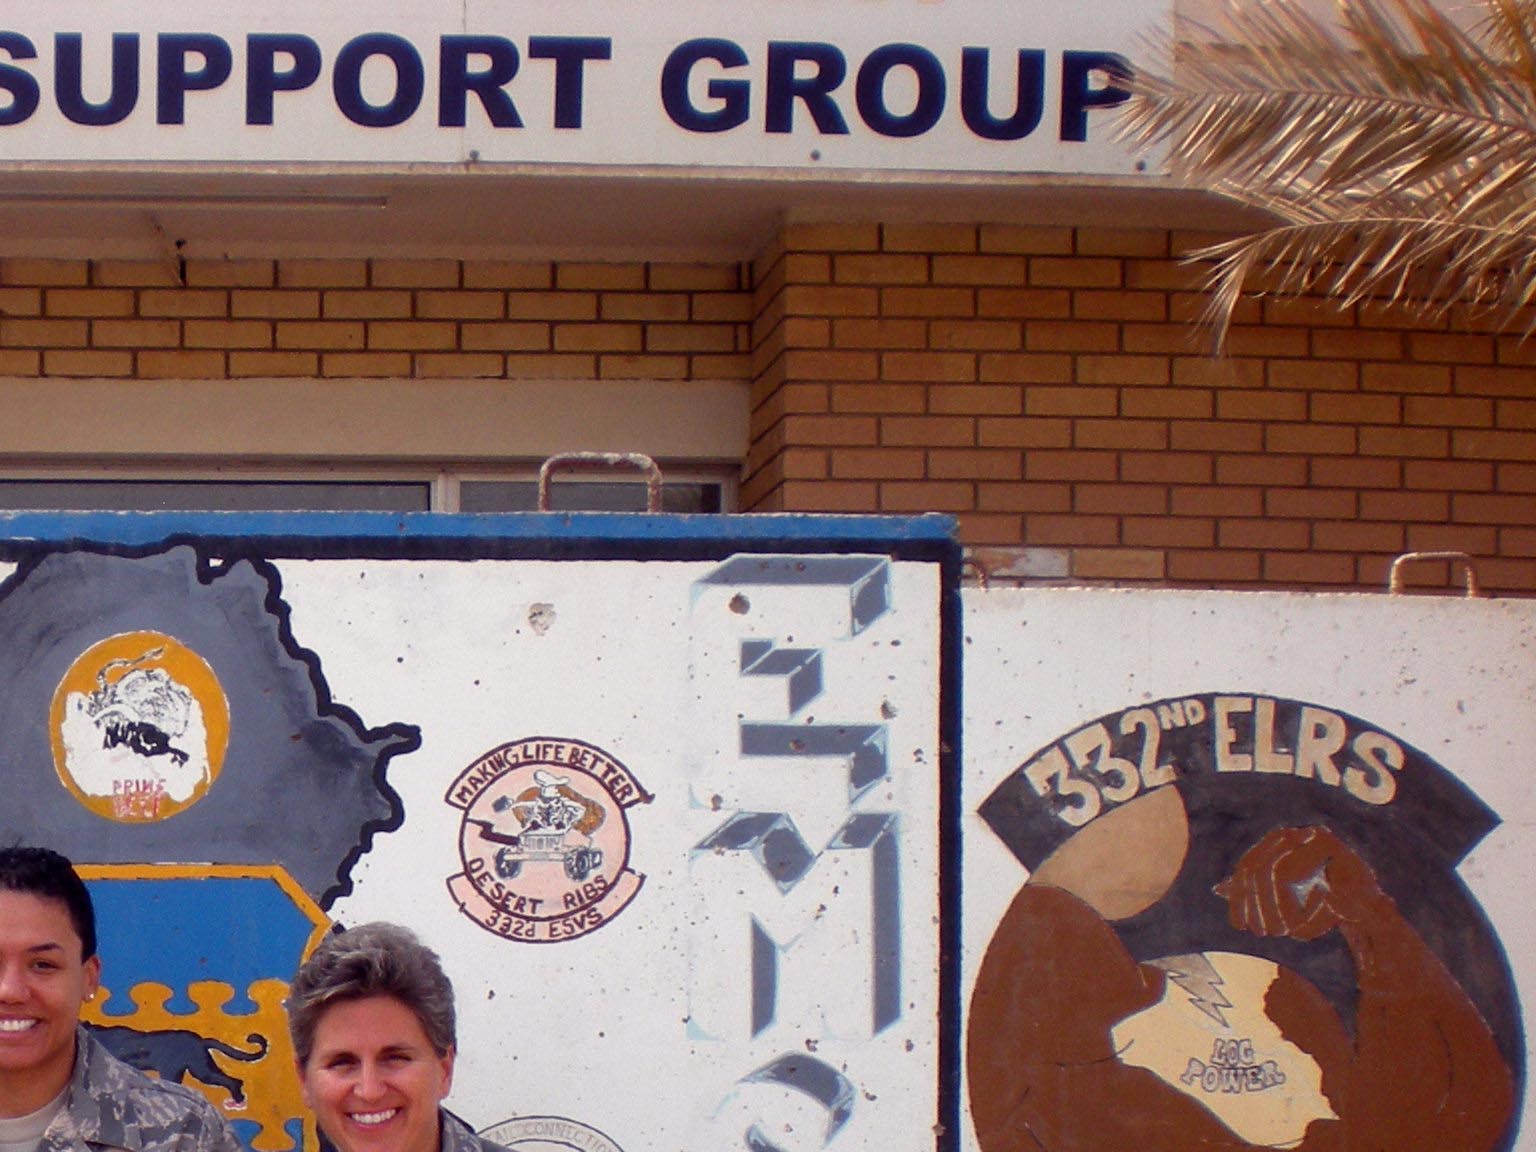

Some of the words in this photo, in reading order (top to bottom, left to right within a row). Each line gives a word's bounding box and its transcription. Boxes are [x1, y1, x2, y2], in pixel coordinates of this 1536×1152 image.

[660, 37, 1138, 143] GROUP
[454, 748, 519, 804] MAKING
[522, 743, 566, 761] LIFE
[567, 746, 635, 802] BETTER
[1213, 696, 1406, 806] ELRS
[467, 856, 544, 915] DESERT
[563, 875, 609, 911] RIBS
[549, 906, 603, 938] ESVS
[1179, 1057, 1286, 1094] POWER
[1210, 1038, 1254, 1066] LOG
